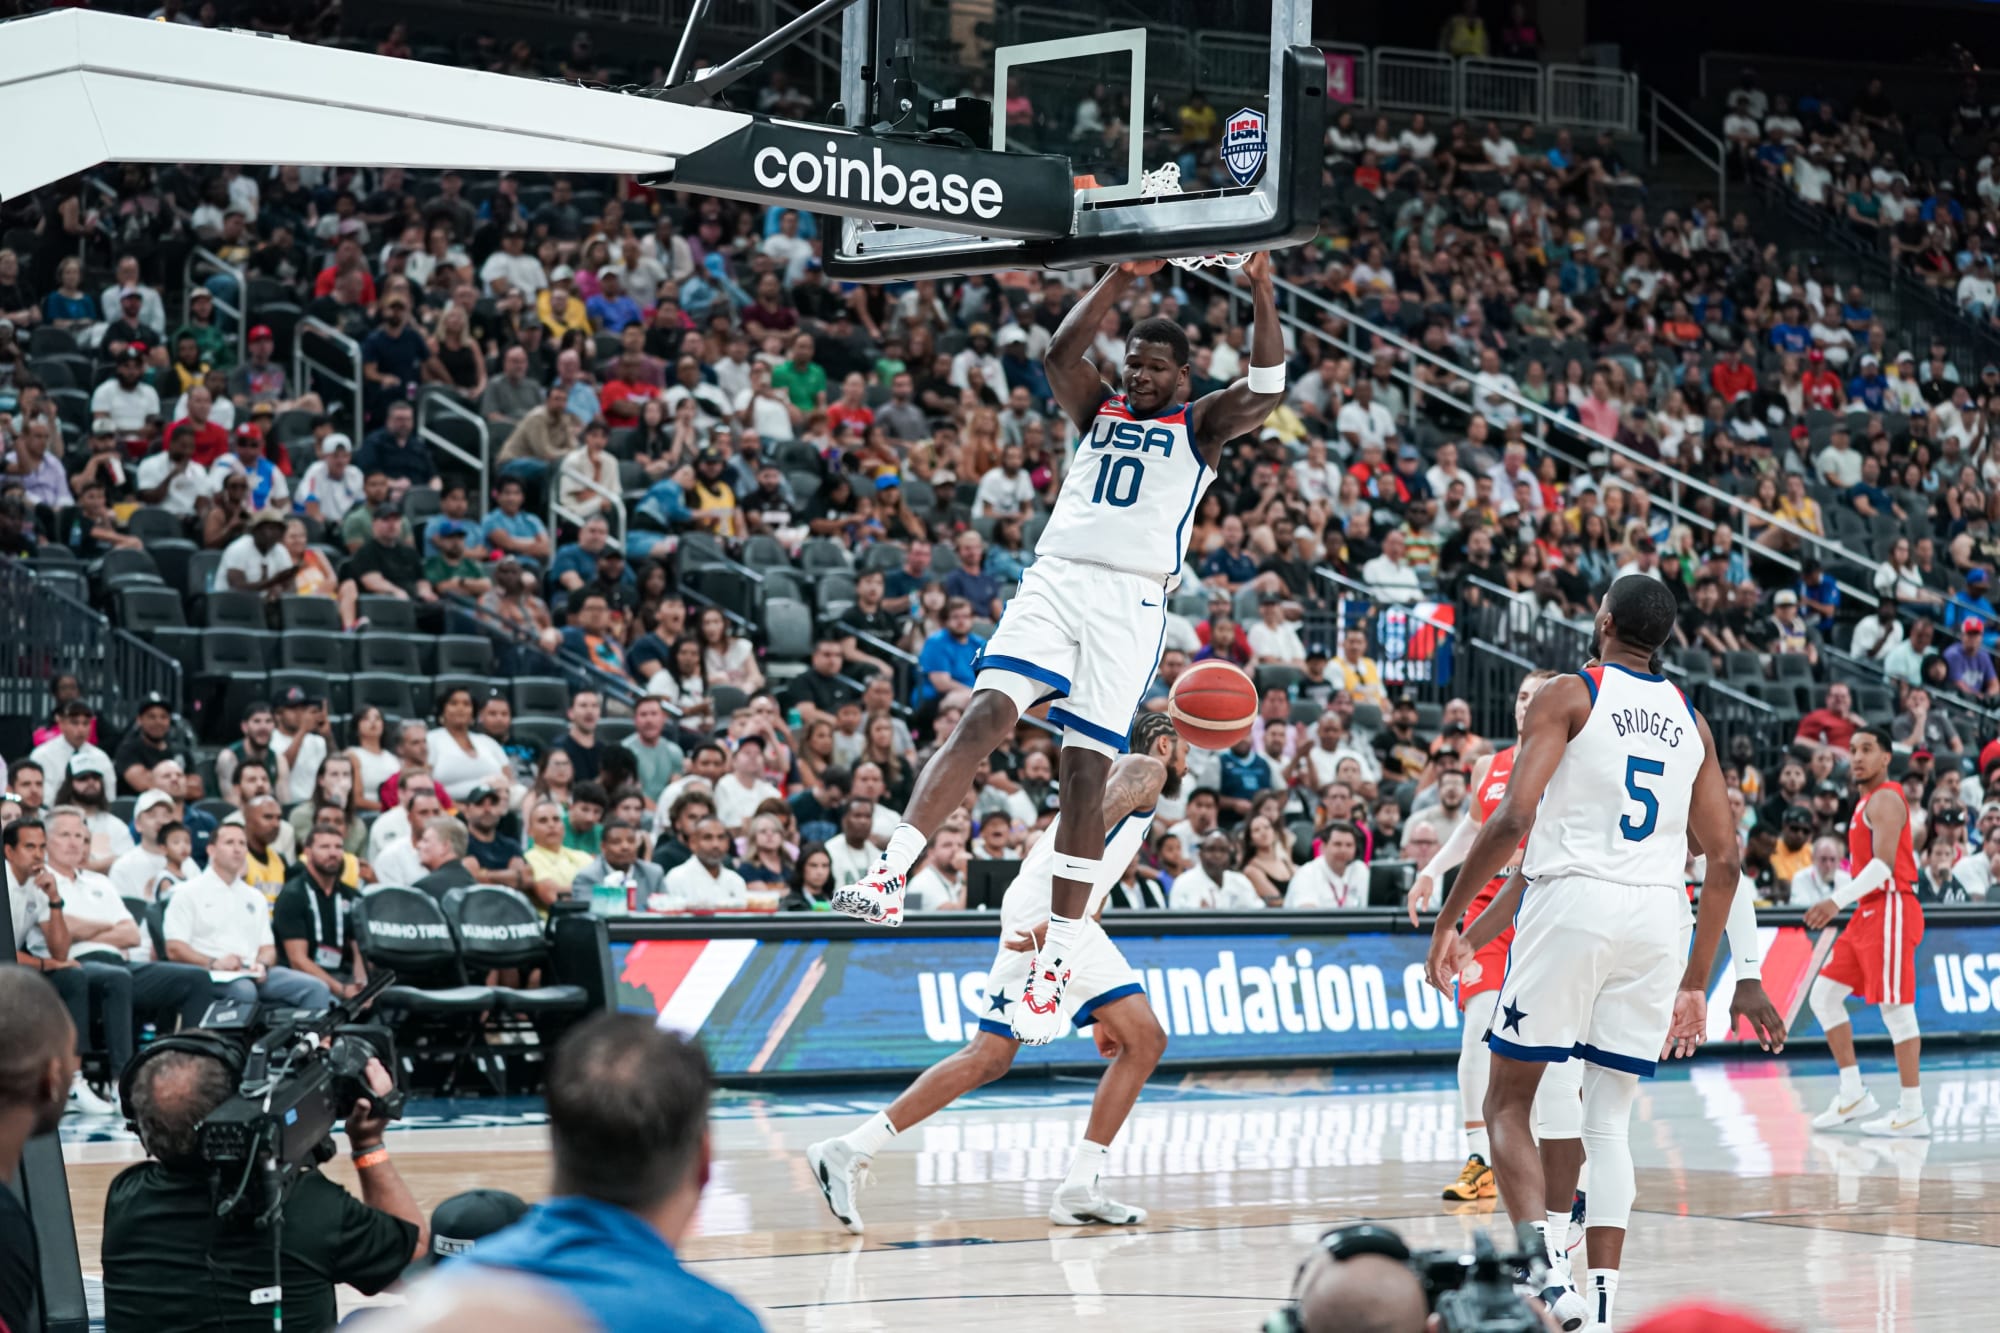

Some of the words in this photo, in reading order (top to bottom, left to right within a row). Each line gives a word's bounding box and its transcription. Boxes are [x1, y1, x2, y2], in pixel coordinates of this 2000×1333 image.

[1223, 144, 1265, 154] BASKETBALL
[1231, 119, 1260, 141] USA
[753, 140, 1003, 219] coinbase
[1090, 421, 1175, 458] USA
[1091, 453, 1145, 508] 10
[1611, 708, 1684, 748] BRIDGES
[1619, 754, 1665, 842] 5
